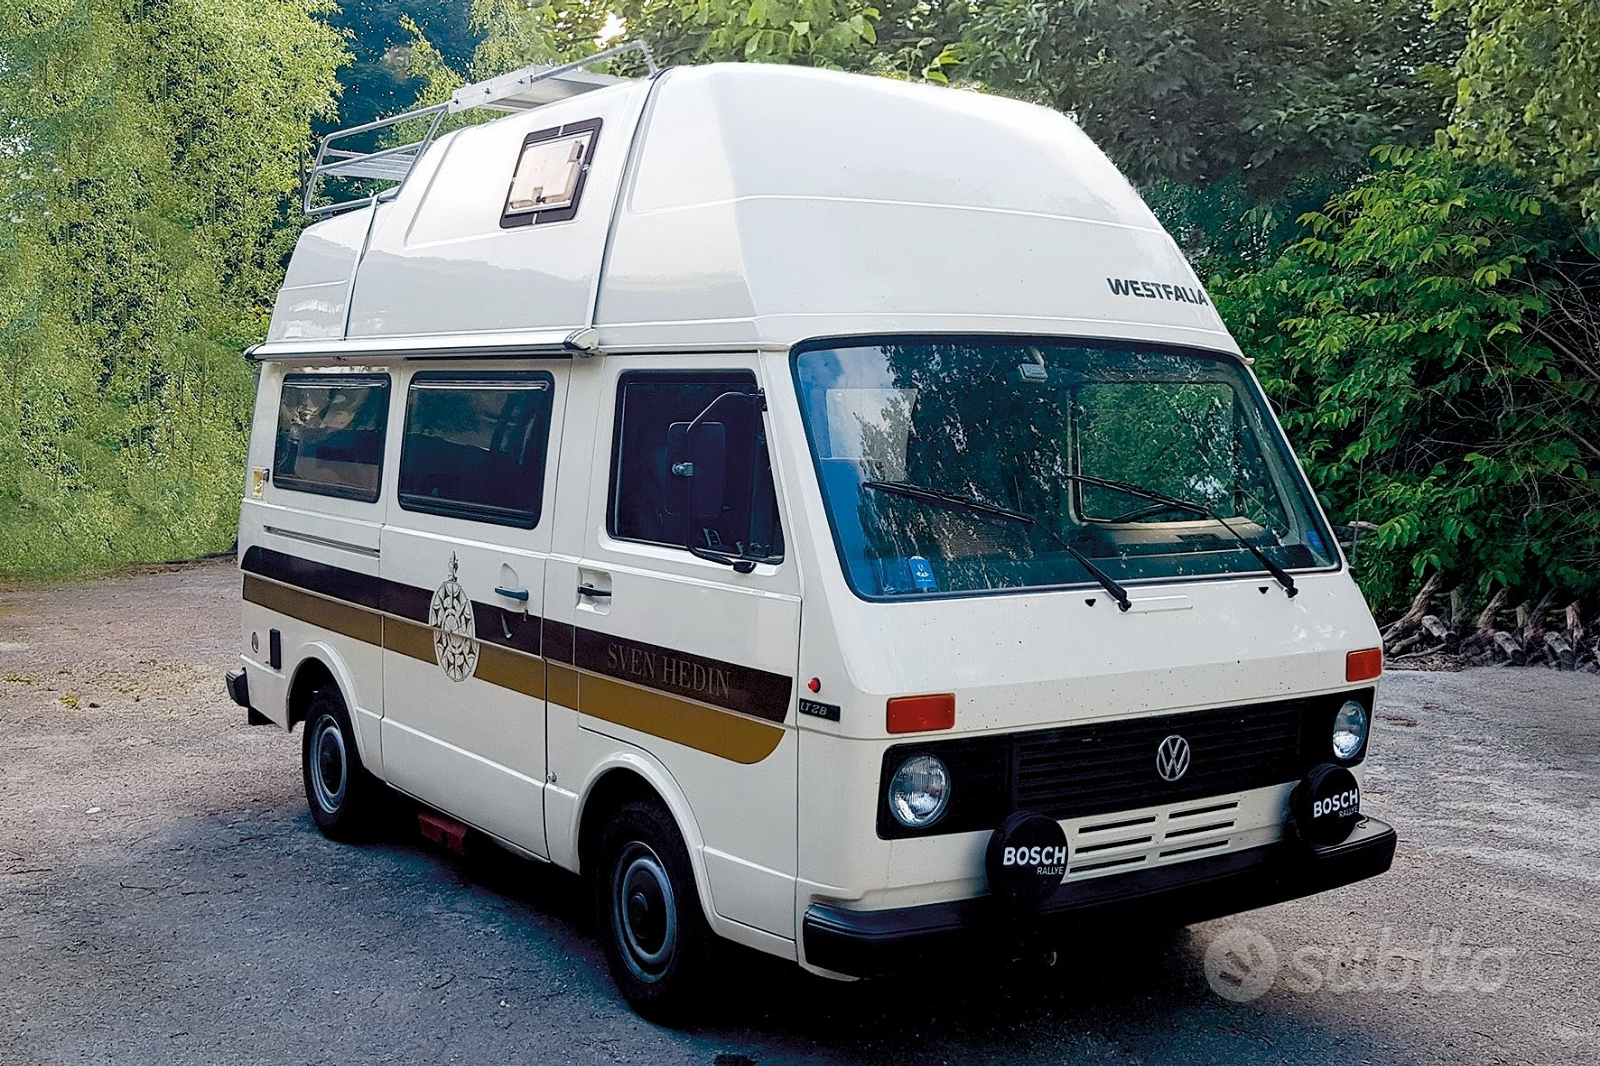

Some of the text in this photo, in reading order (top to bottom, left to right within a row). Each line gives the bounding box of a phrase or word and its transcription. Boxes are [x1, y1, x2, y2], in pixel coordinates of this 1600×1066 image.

[1106, 277, 1209, 306] WESTFALIA
[607, 642, 731, 699] SVEN HEDIN
[1313, 788, 1359, 818] BOSCH
[1338, 805, 1359, 818] RALLYE
[1003, 845, 1067, 866] BOSCH
[1036, 866, 1065, 875] RALLYE
